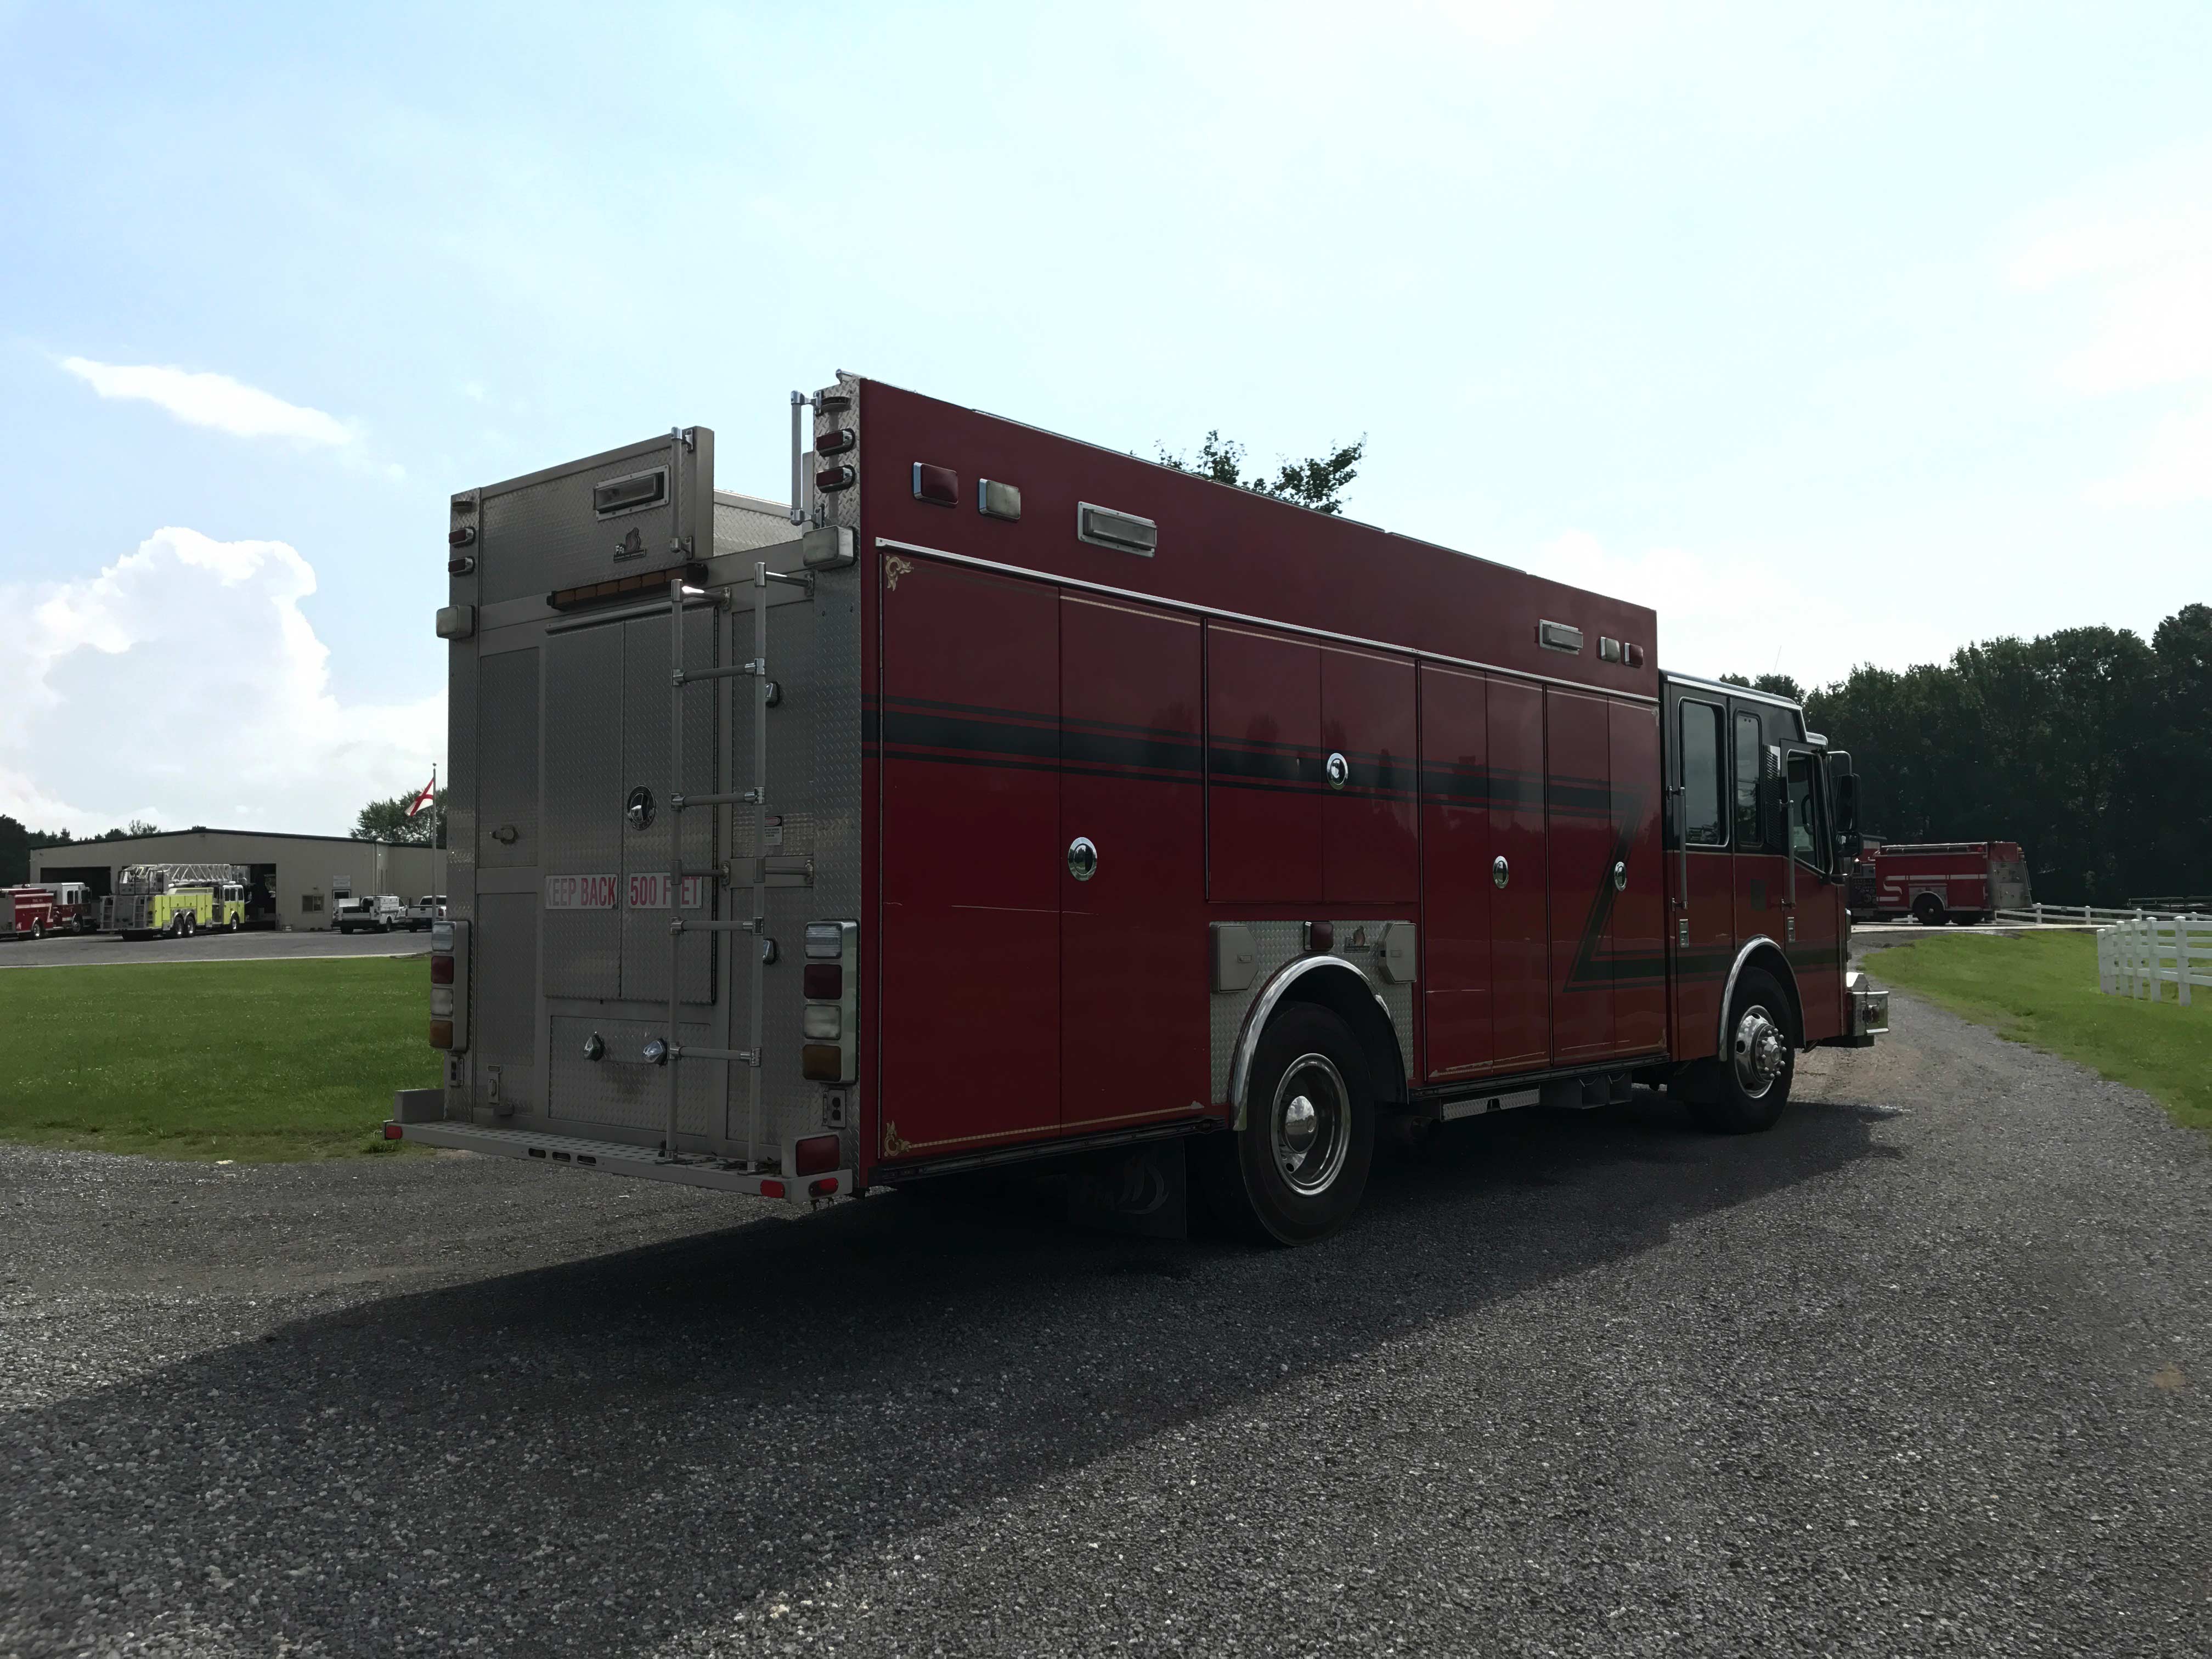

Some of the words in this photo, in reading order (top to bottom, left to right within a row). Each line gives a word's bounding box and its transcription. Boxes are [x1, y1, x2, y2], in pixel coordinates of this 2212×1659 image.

[581, 877, 616, 906] BACK
[630, 876, 657, 905] 500
[663, 876, 700, 905] FET
